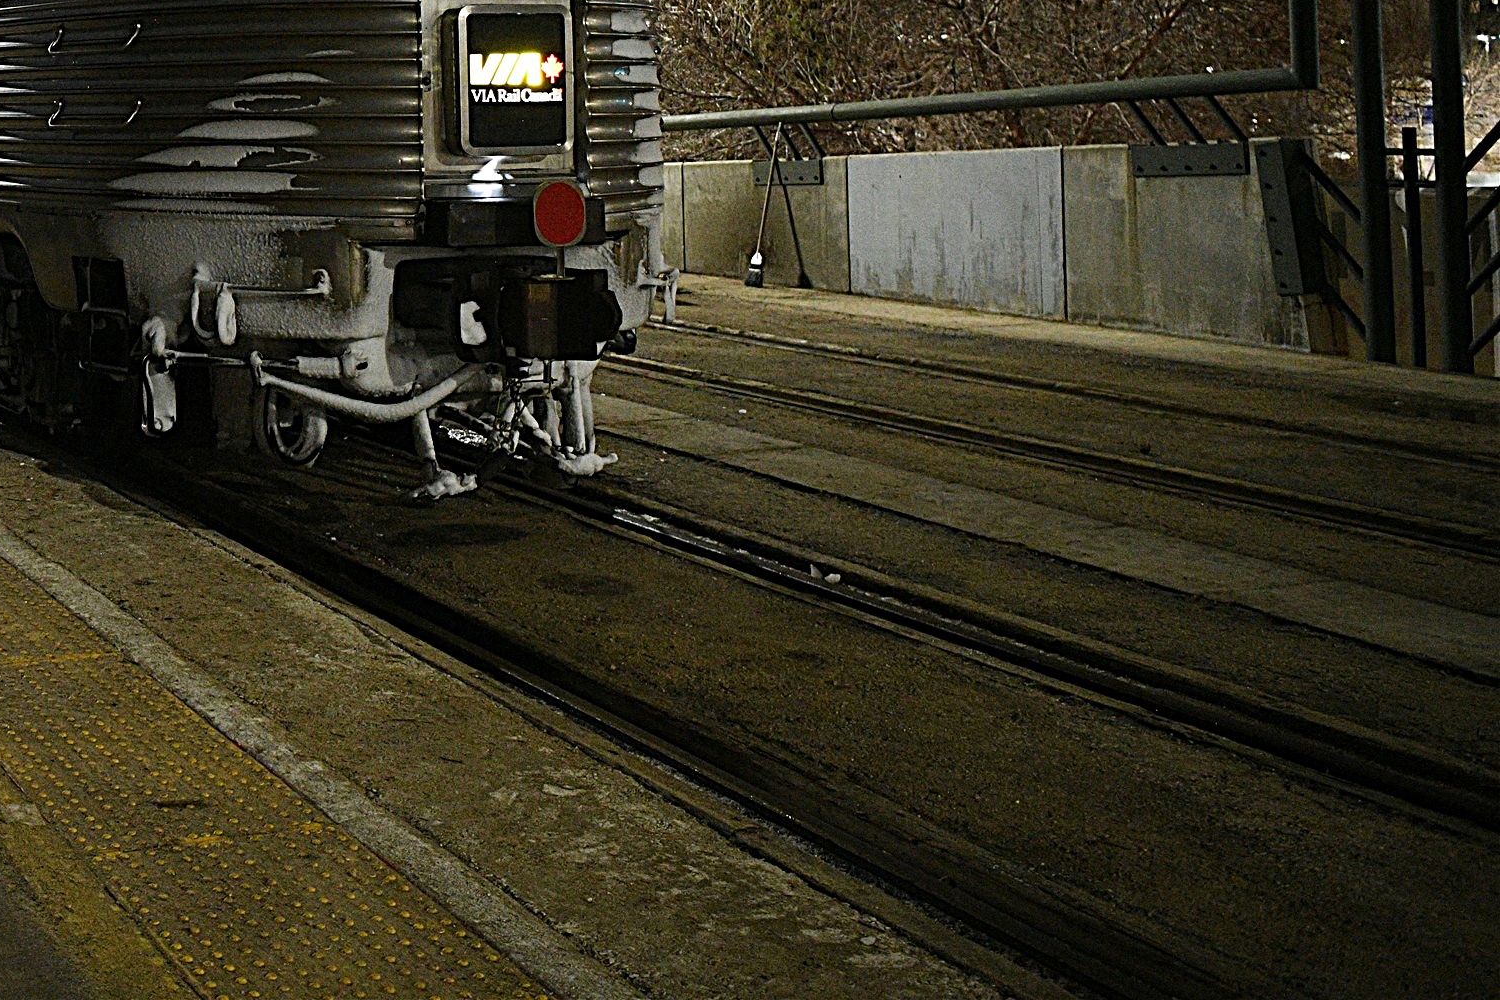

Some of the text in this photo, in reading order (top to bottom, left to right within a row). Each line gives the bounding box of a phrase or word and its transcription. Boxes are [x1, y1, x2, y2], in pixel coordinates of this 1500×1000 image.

[469, 52, 542, 86] VIA
[470, 88, 563, 103] VIA Rail Canada
